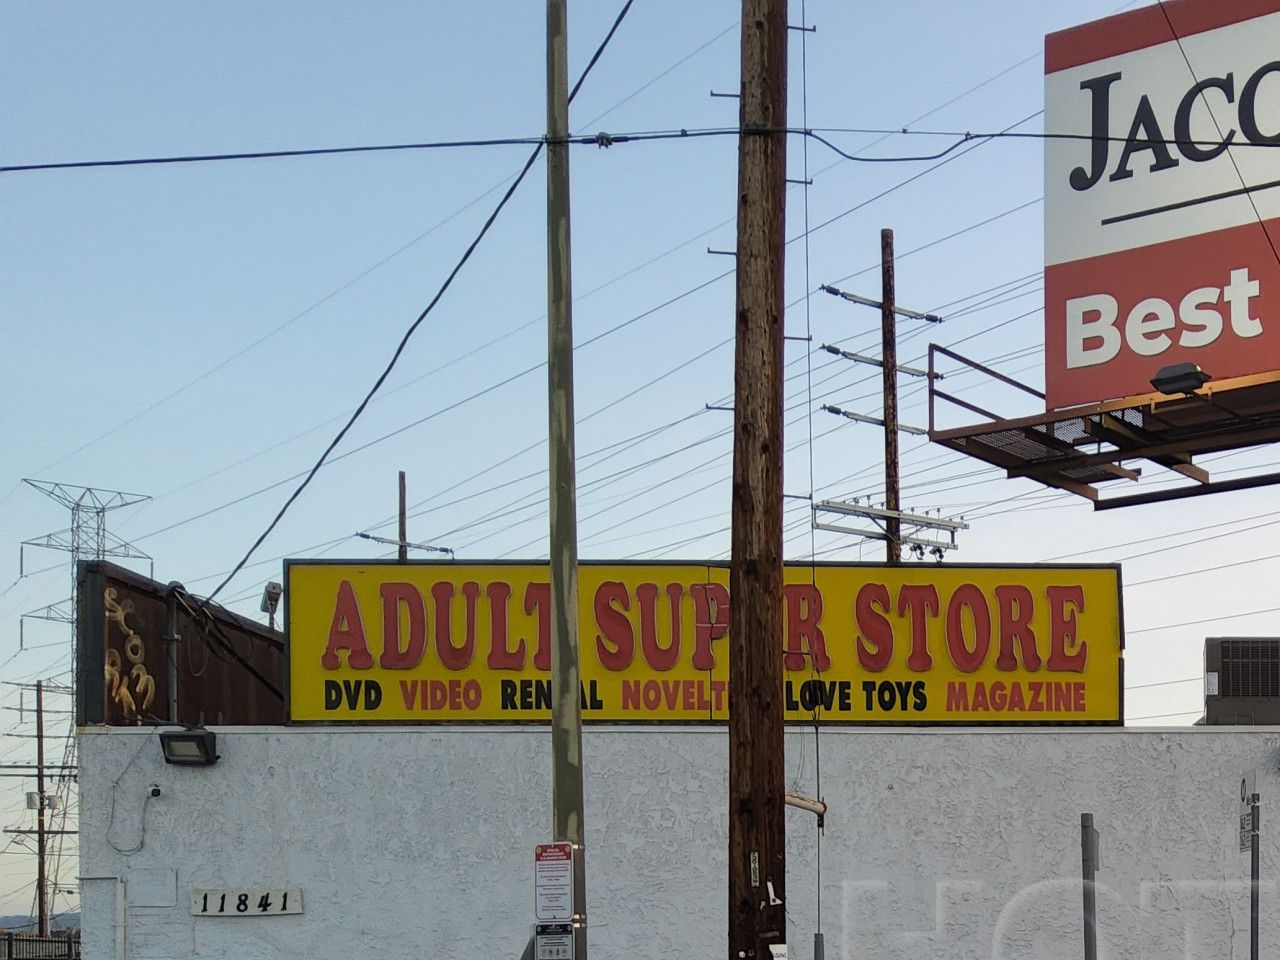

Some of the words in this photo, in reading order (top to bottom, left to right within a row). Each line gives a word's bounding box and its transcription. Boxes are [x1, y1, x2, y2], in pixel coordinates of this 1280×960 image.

[1066, 268, 1263, 369] Best
[593, 580, 831, 672] SUPR
[854, 581, 1088, 674] STORE
[324, 679, 383, 711] DVD
[400, 679, 482, 711] VIDEO
[500, 679, 604, 711] RENL
[621, 680, 730, 712] NOVELT
[785, 680, 852, 712] LOVE
[862, 680, 928, 712] TOYS
[945, 681, 1086, 712] MAGAZINE
[200, 892, 288, 913] 11841
